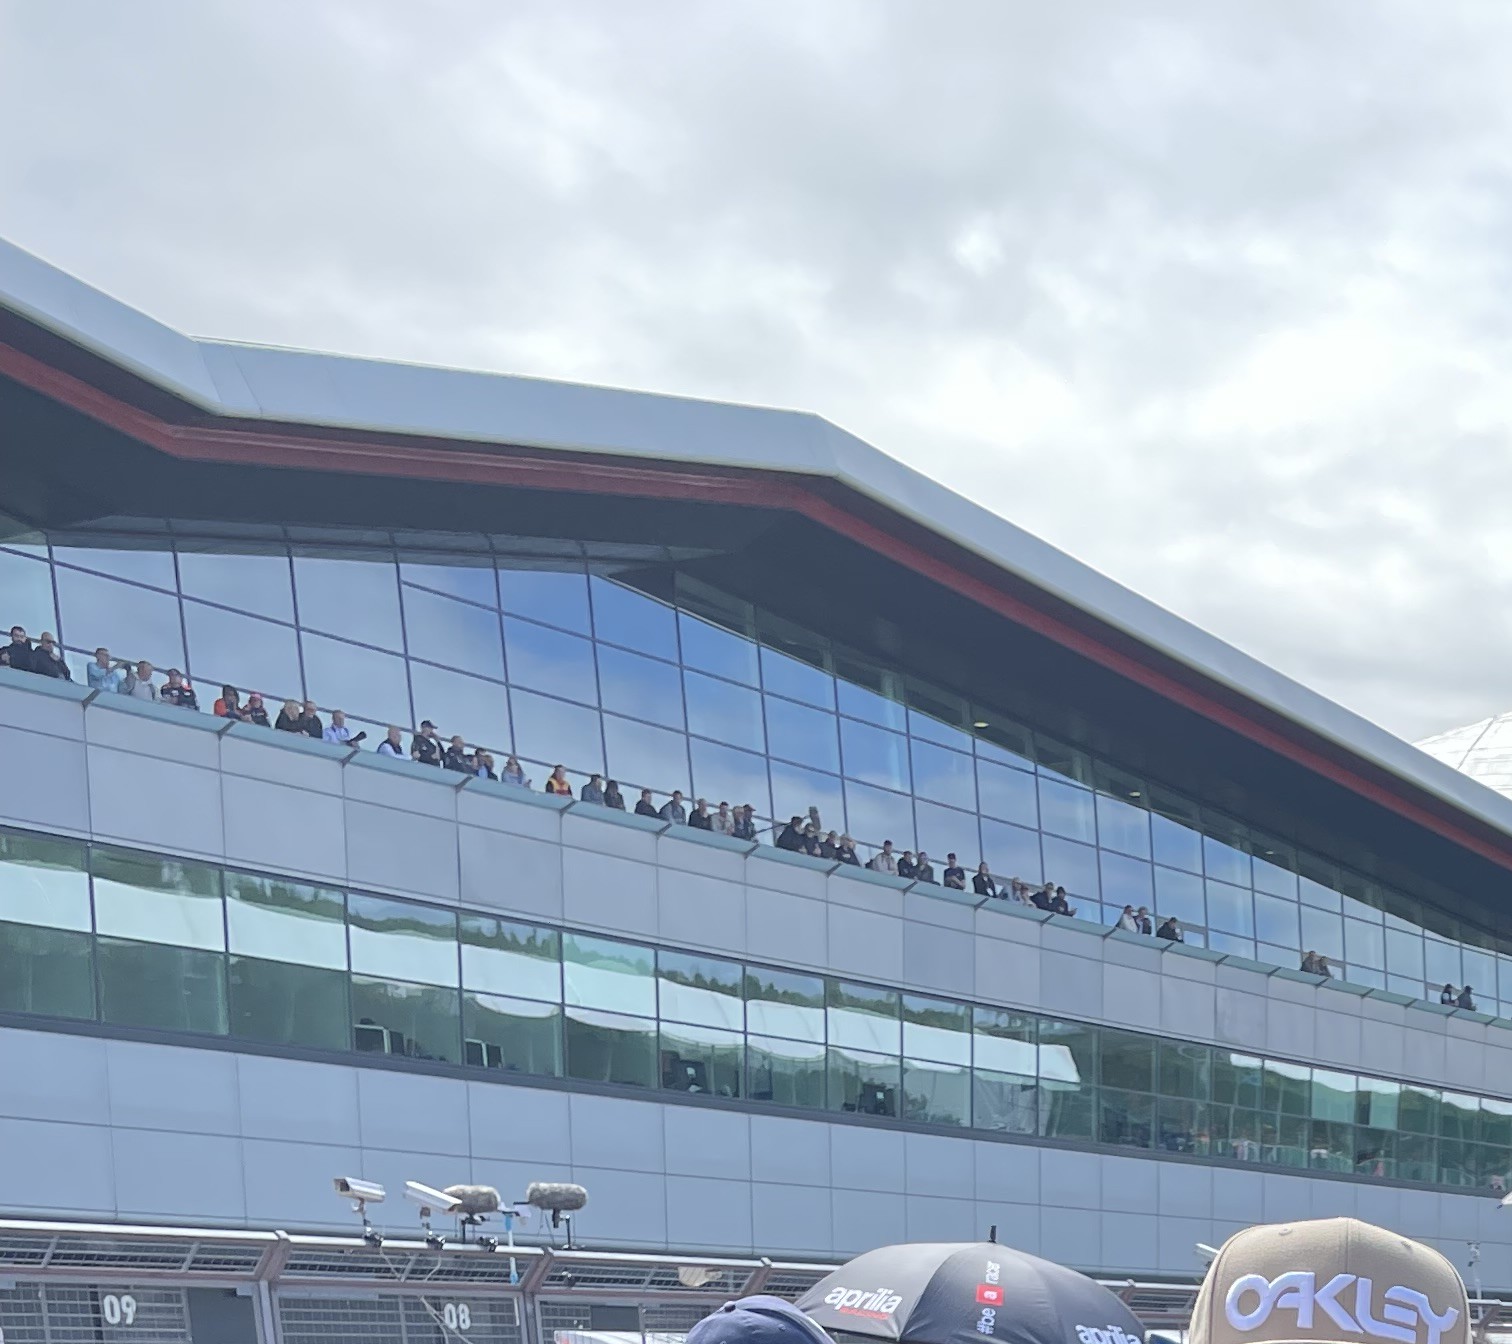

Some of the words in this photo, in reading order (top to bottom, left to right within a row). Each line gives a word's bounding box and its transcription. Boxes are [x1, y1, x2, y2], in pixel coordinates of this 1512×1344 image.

[104, 1294, 137, 1325] 09
[824, 1286, 903, 1315] aprilia
[444, 1303, 472, 1331] 08
